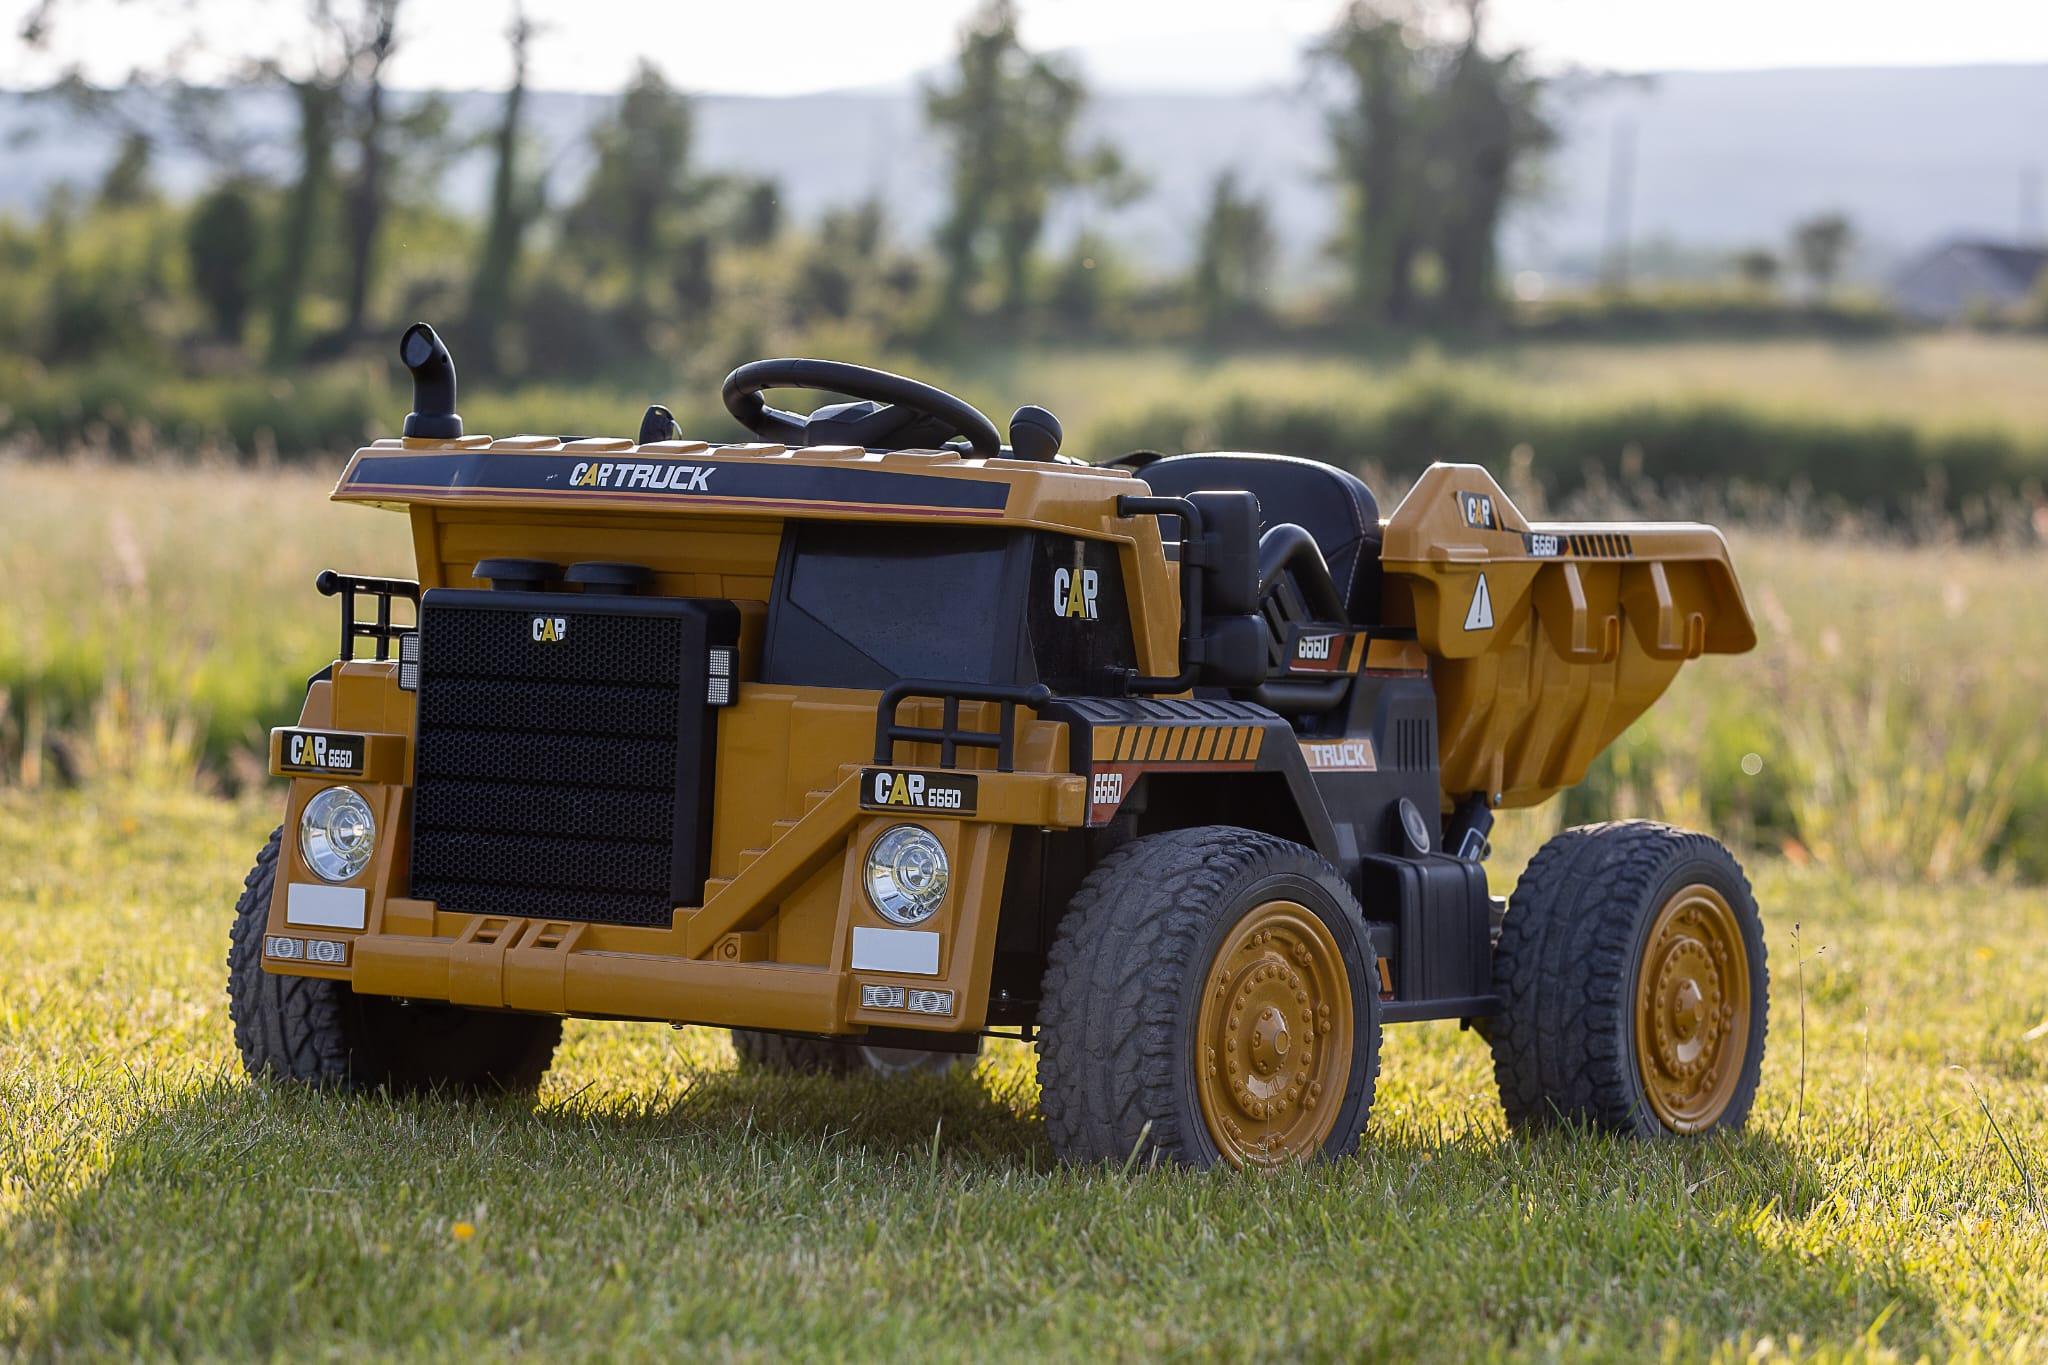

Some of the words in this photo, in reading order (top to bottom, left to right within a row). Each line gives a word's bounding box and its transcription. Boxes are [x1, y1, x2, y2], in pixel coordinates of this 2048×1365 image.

[1467, 496, 1490, 526] CAR
[1533, 535, 1558, 556] 666D
[1054, 568, 1098, 618] CAR
[532, 618, 566, 641] CAR
[291, 735, 327, 766] CAR
[328, 749, 352, 768] 666D
[1311, 744, 1368, 767] TRUCK
[875, 773, 925, 806] CAR
[928, 788, 962, 808] 666D
[1093, 773, 1123, 804] 666D
